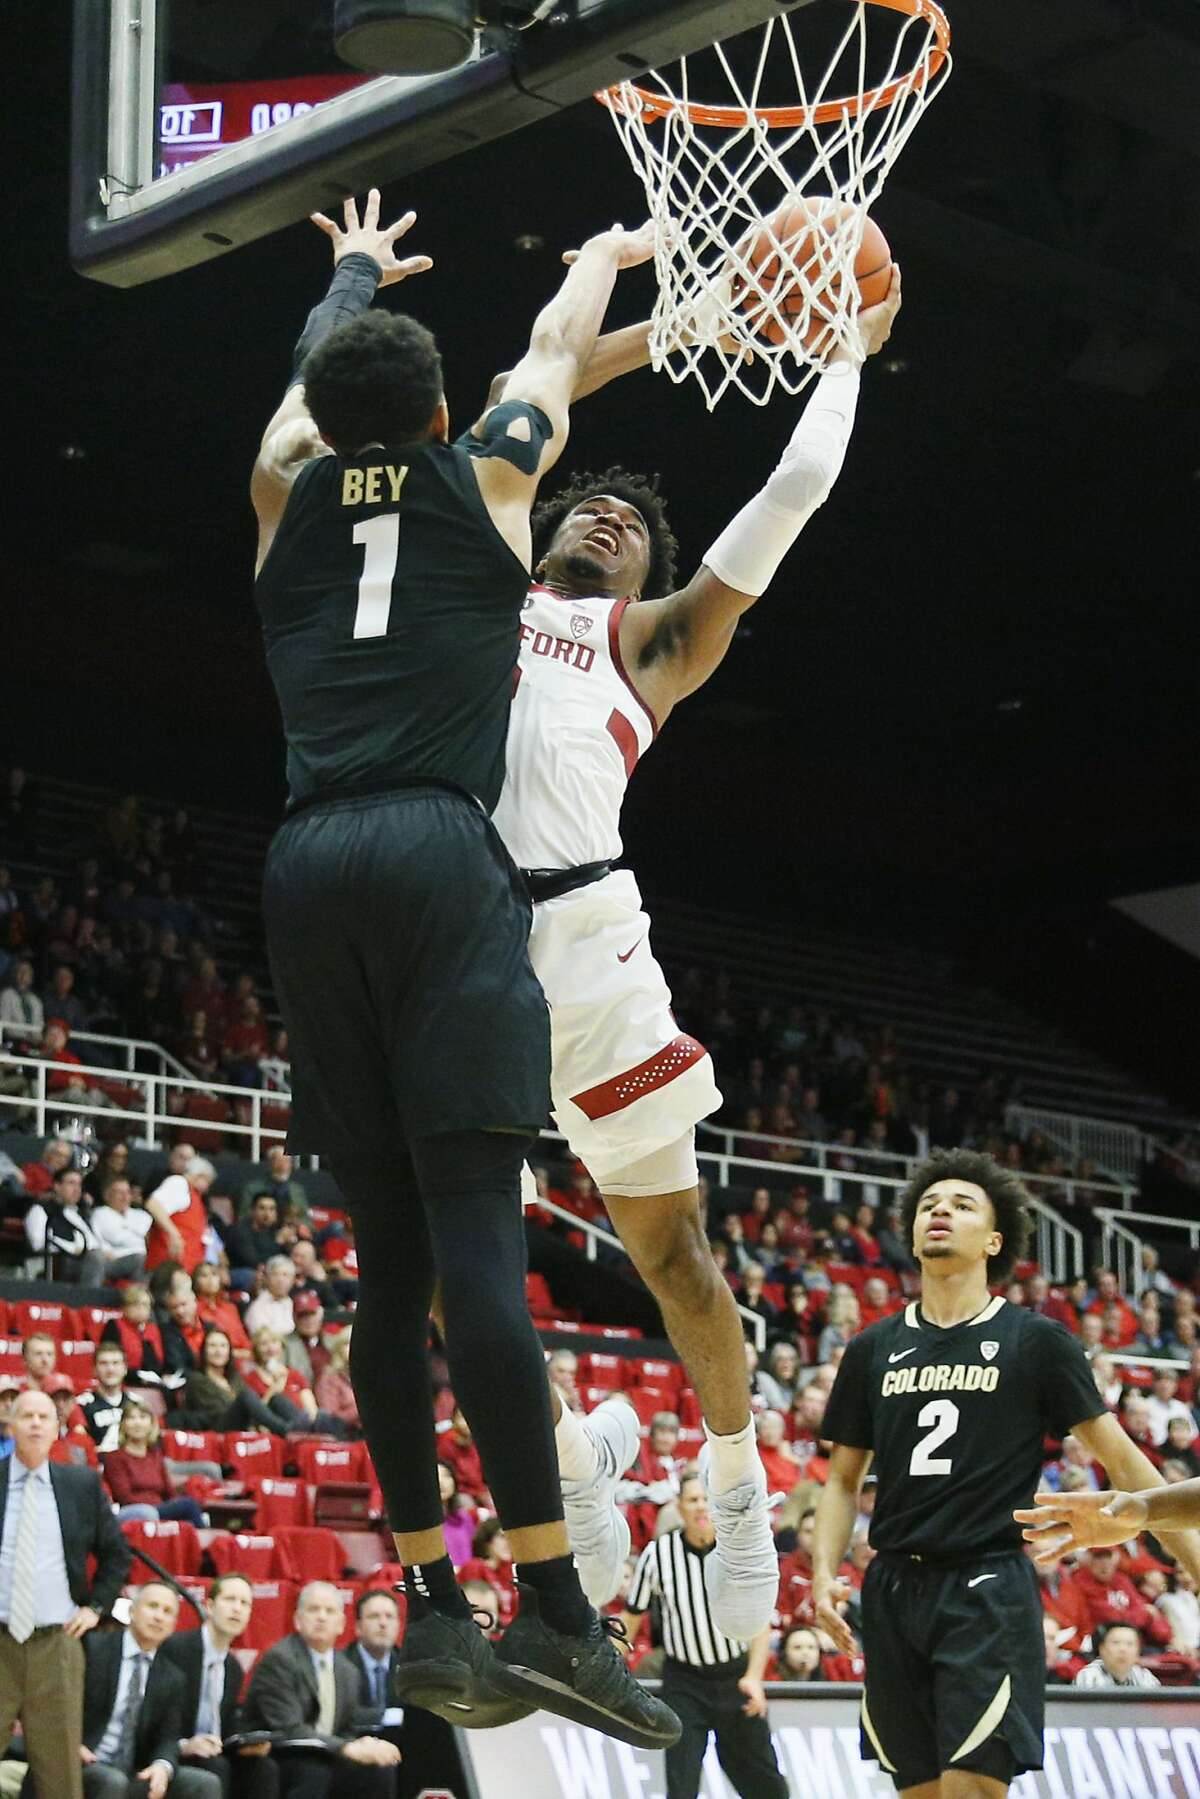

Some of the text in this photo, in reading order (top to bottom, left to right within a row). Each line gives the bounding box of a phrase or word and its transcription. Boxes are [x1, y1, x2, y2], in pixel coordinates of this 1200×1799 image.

[342, 465, 409, 506] BEY
[353, 512, 400, 640] 1
[881, 1364, 1001, 1398] COLORADO
[909, 1399, 960, 1476] 2
[1008, 1727, 1200, 1799] TANFO
